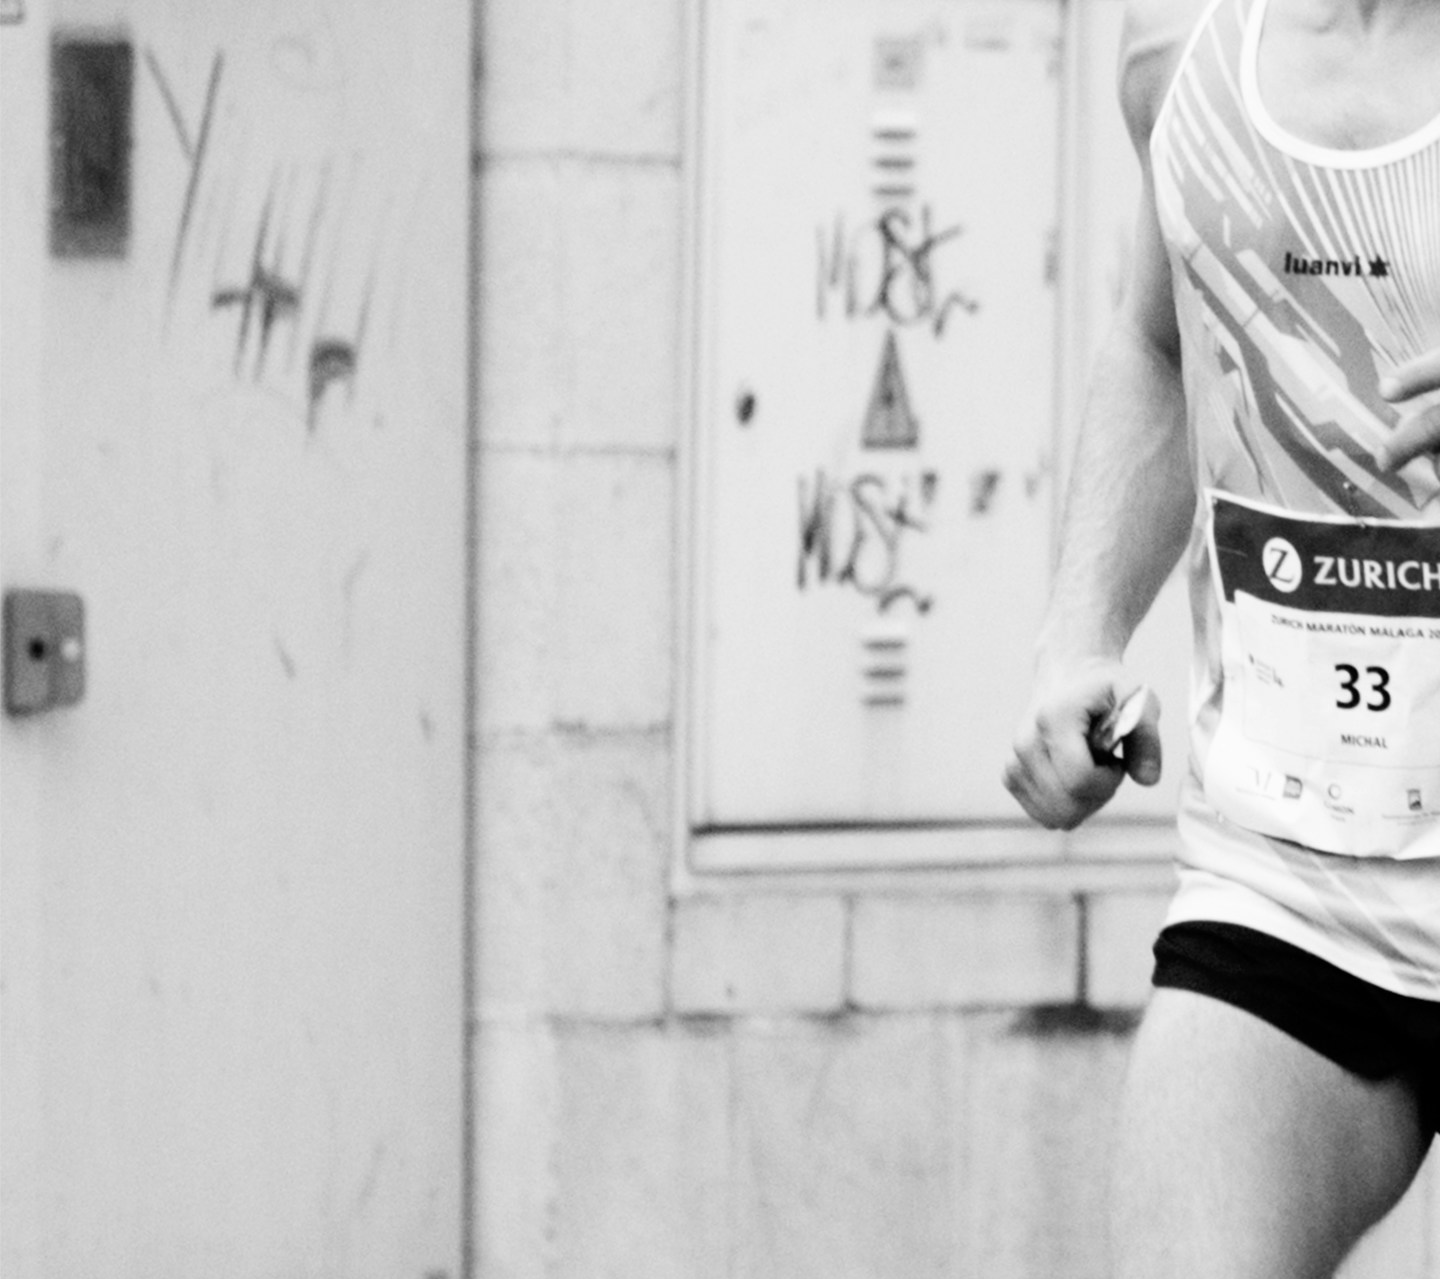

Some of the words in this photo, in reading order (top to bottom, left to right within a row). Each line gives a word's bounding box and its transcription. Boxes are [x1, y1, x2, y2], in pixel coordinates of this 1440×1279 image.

[1284, 251, 1361, 277] luanvi
[1333, 662, 1393, 712] 33
[1340, 732, 1389, 750] MICHAL
